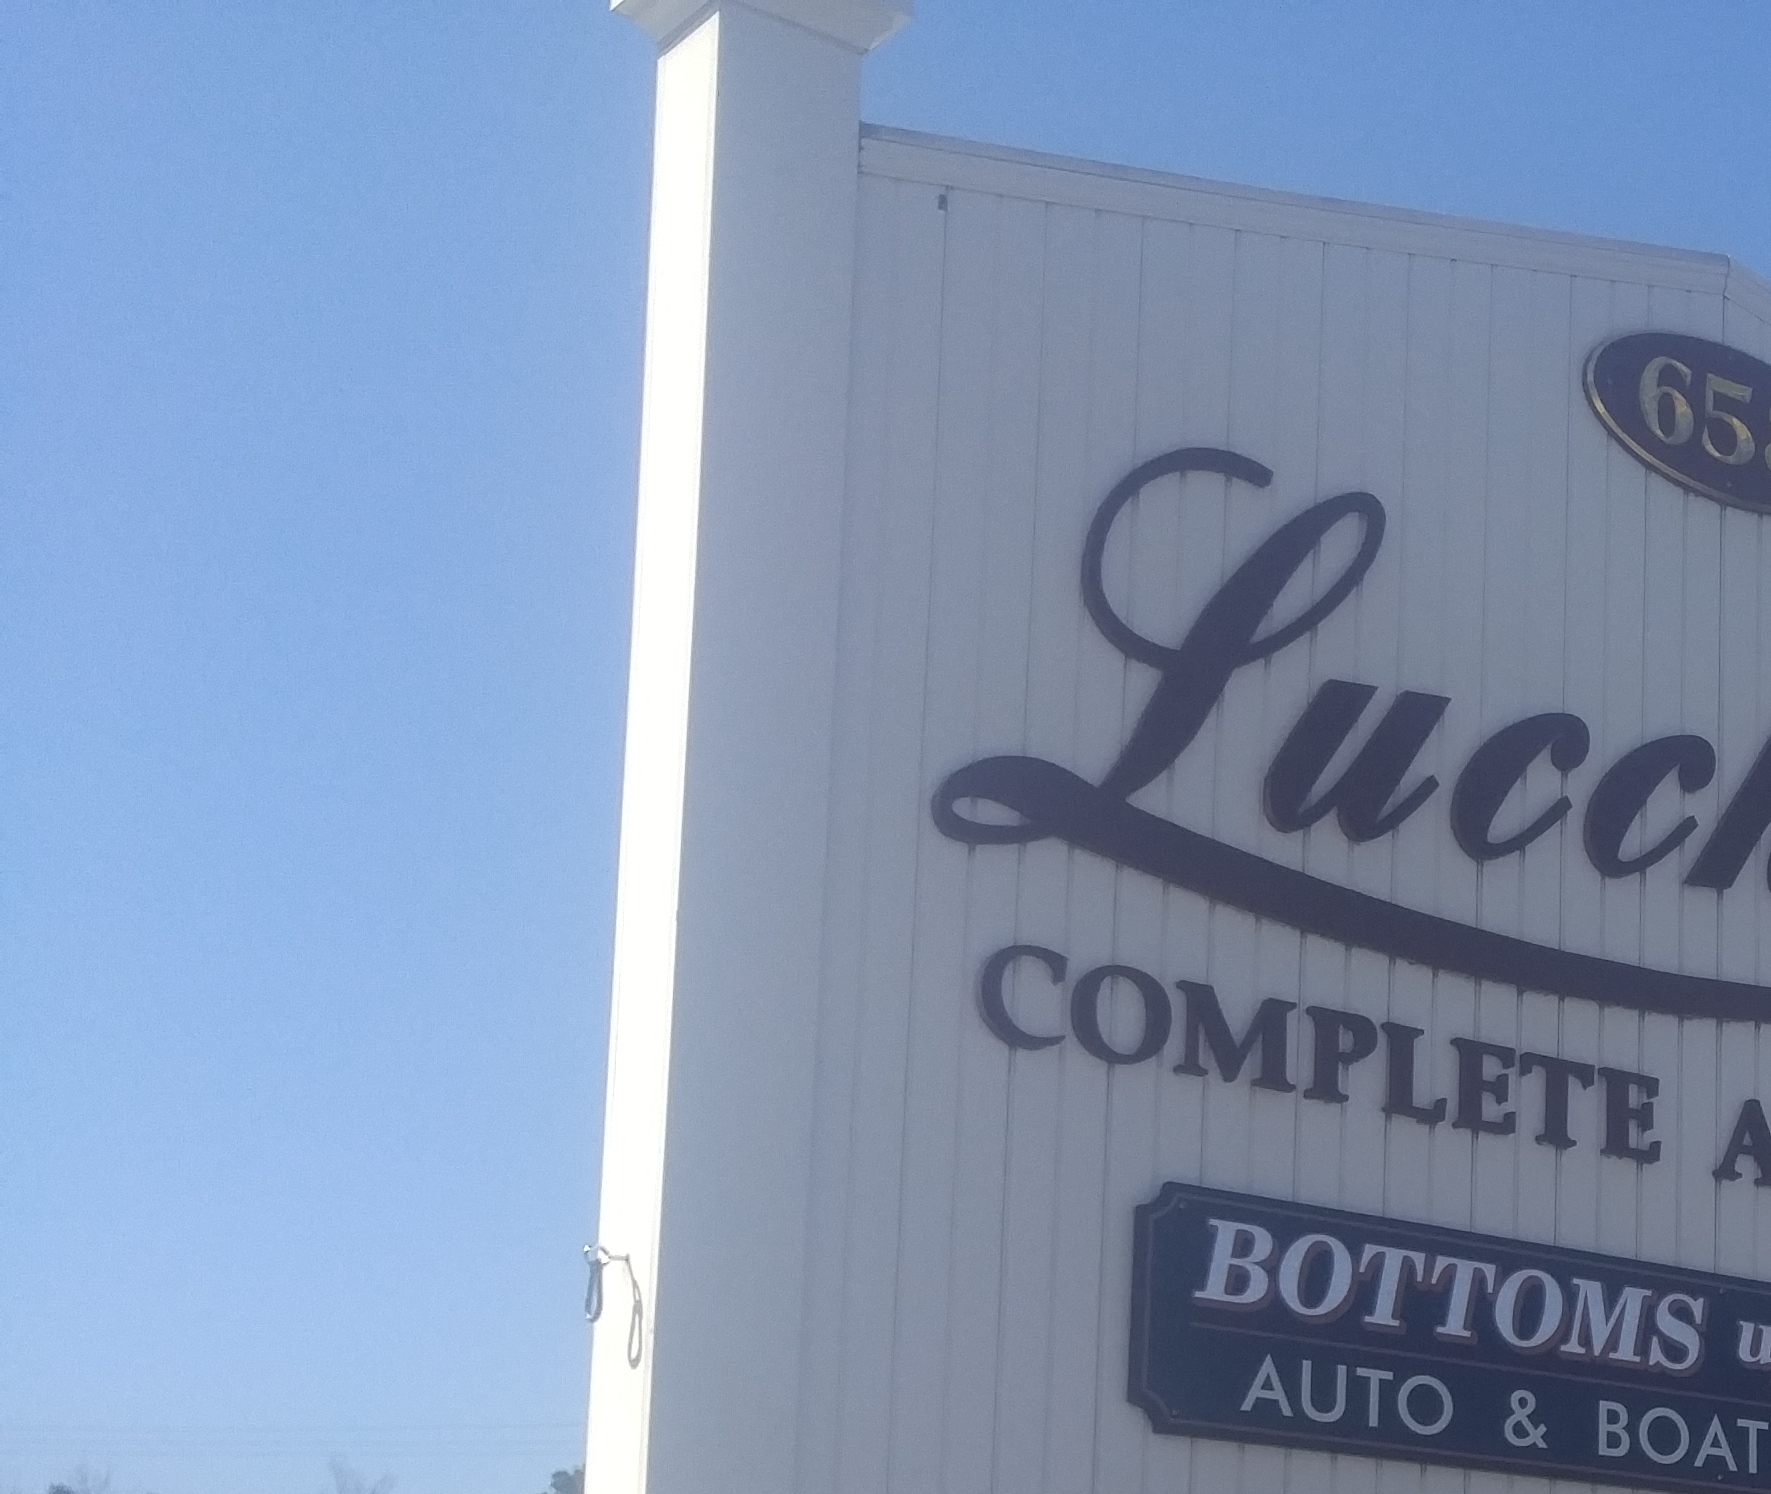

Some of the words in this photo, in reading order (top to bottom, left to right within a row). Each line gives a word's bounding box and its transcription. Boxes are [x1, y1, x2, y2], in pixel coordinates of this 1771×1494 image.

[977, 944, 1662, 1164] COMPLETE
[1194, 1217, 1707, 1374] BOTTOMS
[1240, 1354, 1454, 1437] AUTO
[1504, 1388, 1549, 1451] &
[1597, 1399, 1770, 1476] BOAT
